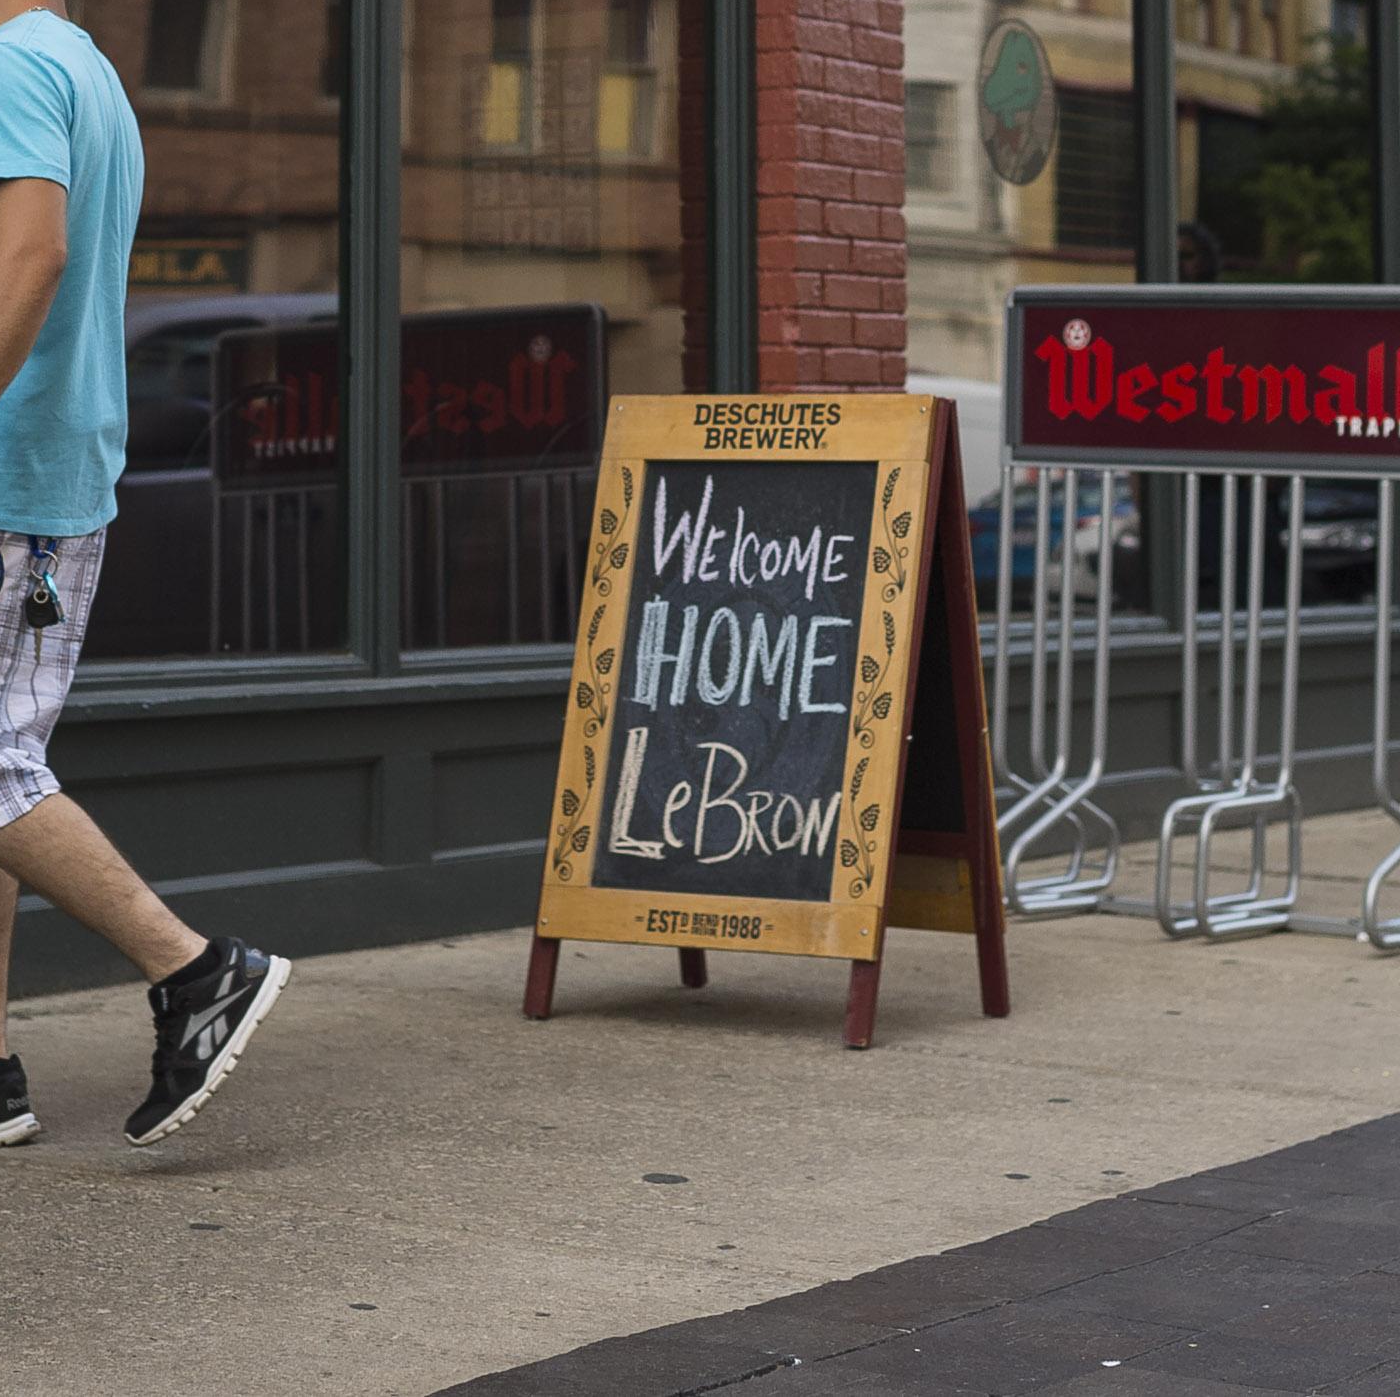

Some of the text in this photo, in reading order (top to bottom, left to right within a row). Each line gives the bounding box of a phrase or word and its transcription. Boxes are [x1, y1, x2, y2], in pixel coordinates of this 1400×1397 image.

[694, 403, 842, 426] DESCHUTES
[704, 428, 827, 450] BREWERY
[630, 593, 853, 721] HOME
[721, 914, 762, 940] 1988
